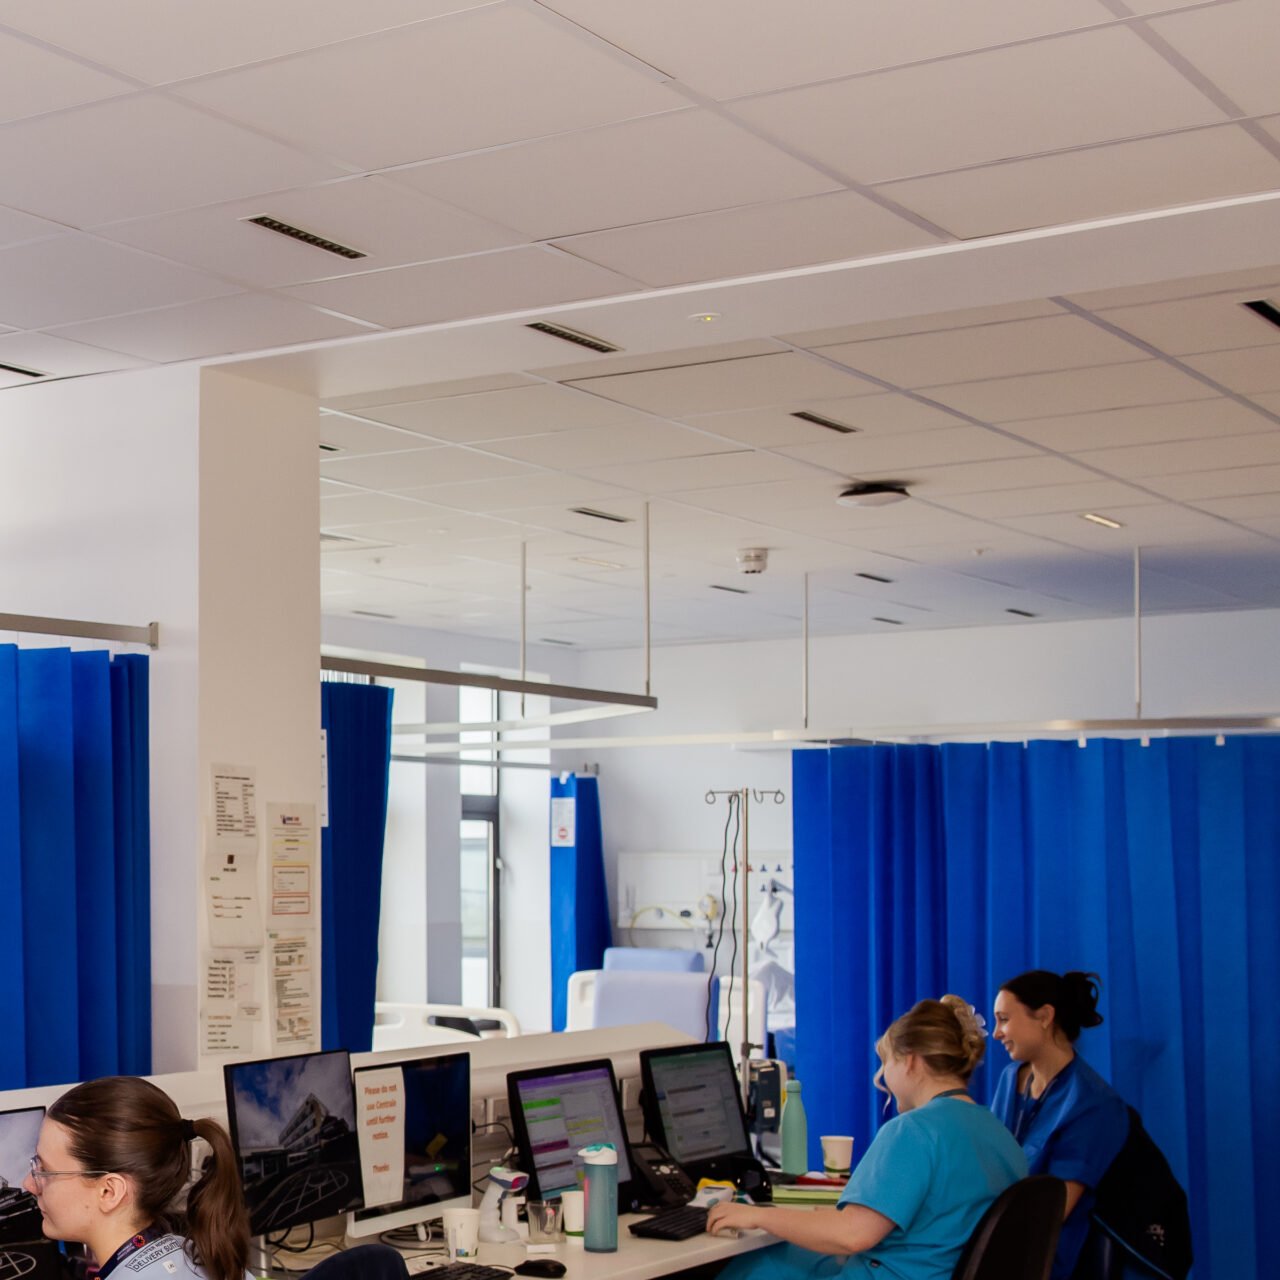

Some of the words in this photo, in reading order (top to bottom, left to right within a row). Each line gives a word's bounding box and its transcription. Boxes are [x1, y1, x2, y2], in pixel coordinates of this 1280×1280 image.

[364, 1086, 380, 1095] Please
[381, 1085, 388, 1093] do
[389, 1084, 397, 1092] not
[133, 1249, 165, 1270] DELIVERY
